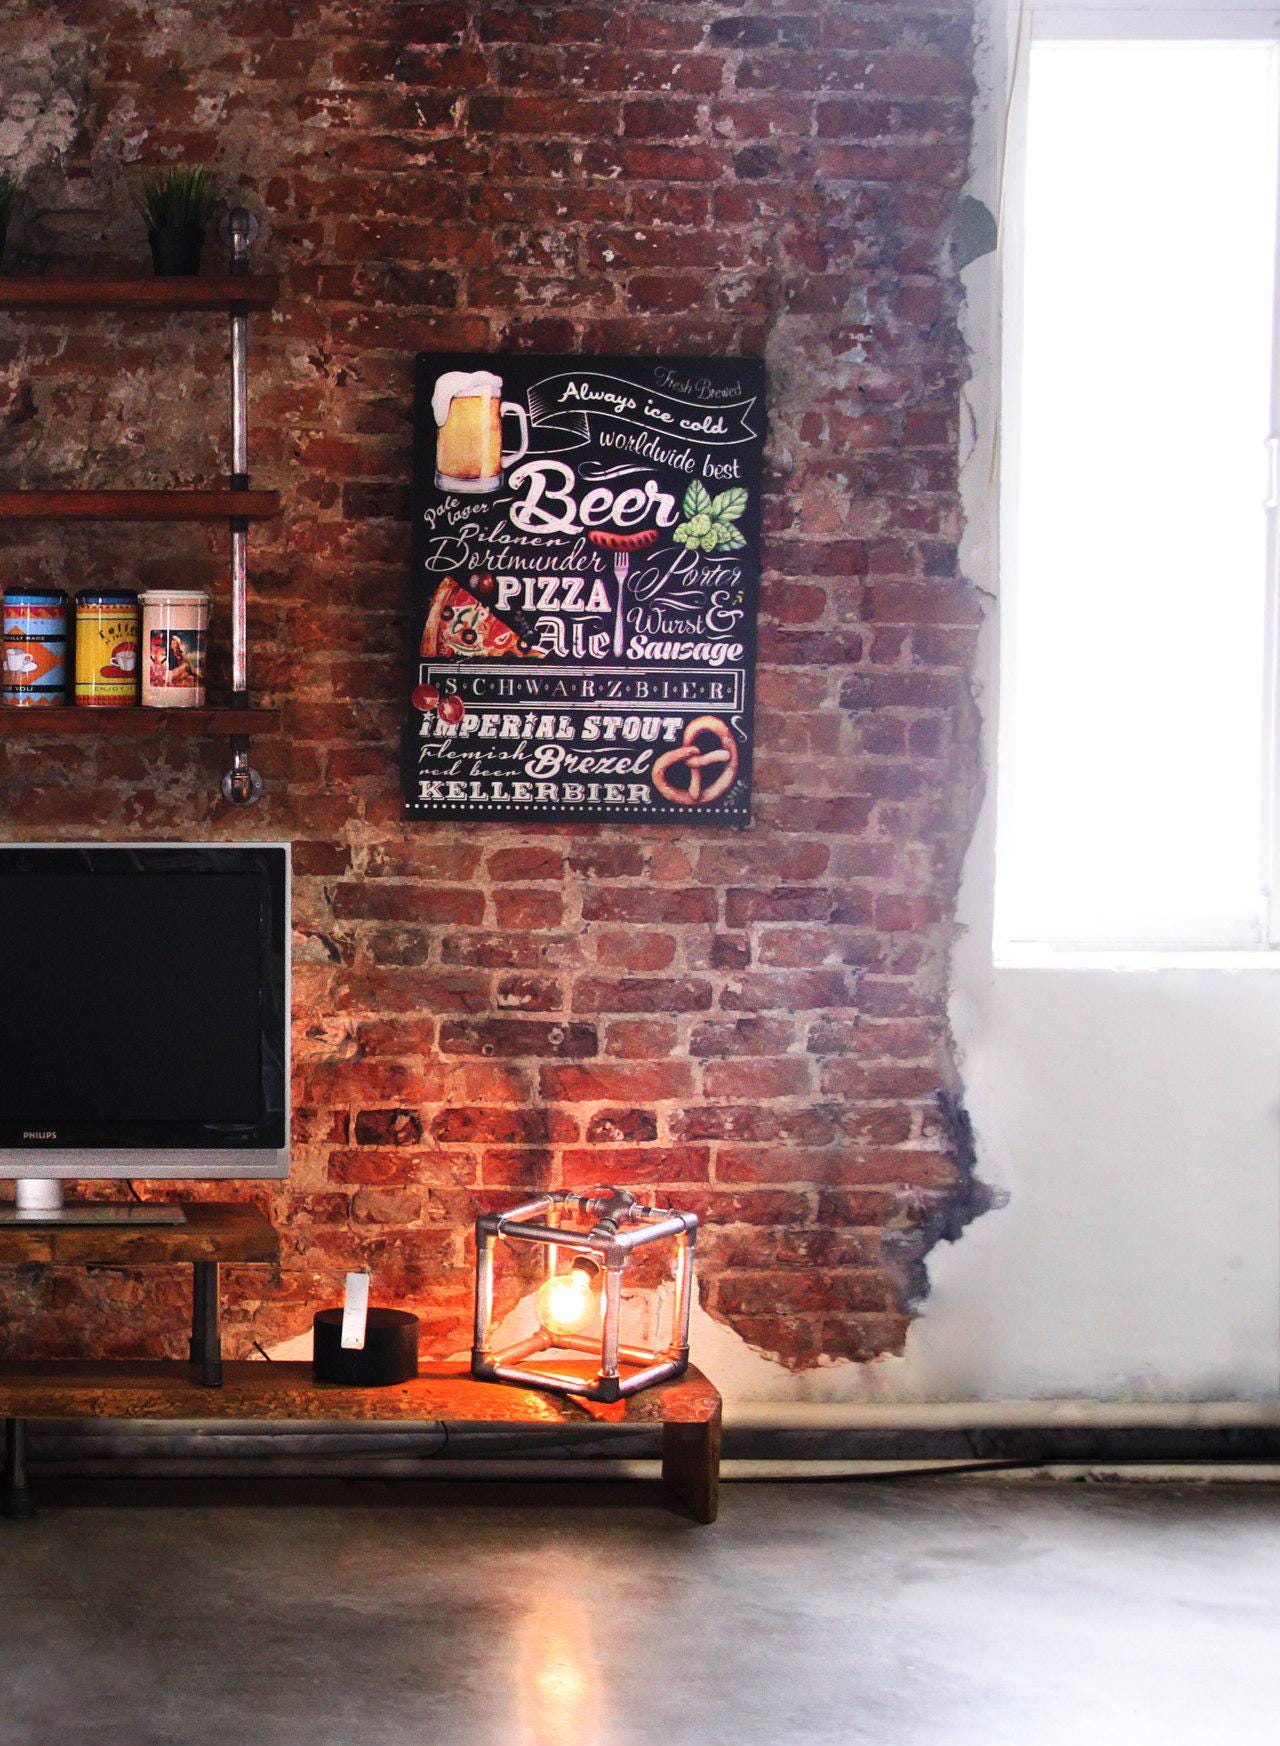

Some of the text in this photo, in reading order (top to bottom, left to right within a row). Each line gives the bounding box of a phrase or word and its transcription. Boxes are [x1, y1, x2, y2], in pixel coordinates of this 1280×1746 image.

[654, 366, 741, 400] Fresh Brewed
[557, 381, 728, 435] Always ice cold
[599, 430, 741, 480] worldwide best
[423, 495, 460, 529] Pale
[447, 502, 489, 525] lager
[508, 459, 680, 535] Beer
[425, 537, 606, 573] Dortmunder
[628, 547, 741, 602] Porter
[495, 575, 612, 613] PIZZA
[627, 589, 744, 635] Wurst &
[532, 616, 611, 659] Ale
[627, 634, 744, 667] Sausage
[581, 716, 684, 742] STOUT
[418, 739, 533, 763] Flemish
[419, 759, 521, 777] red beer
[524, 744, 654, 779] Brezel
[418, 780, 652, 805] KELLERBIER
[23, 1131, 57, 1139] PHILIPS
